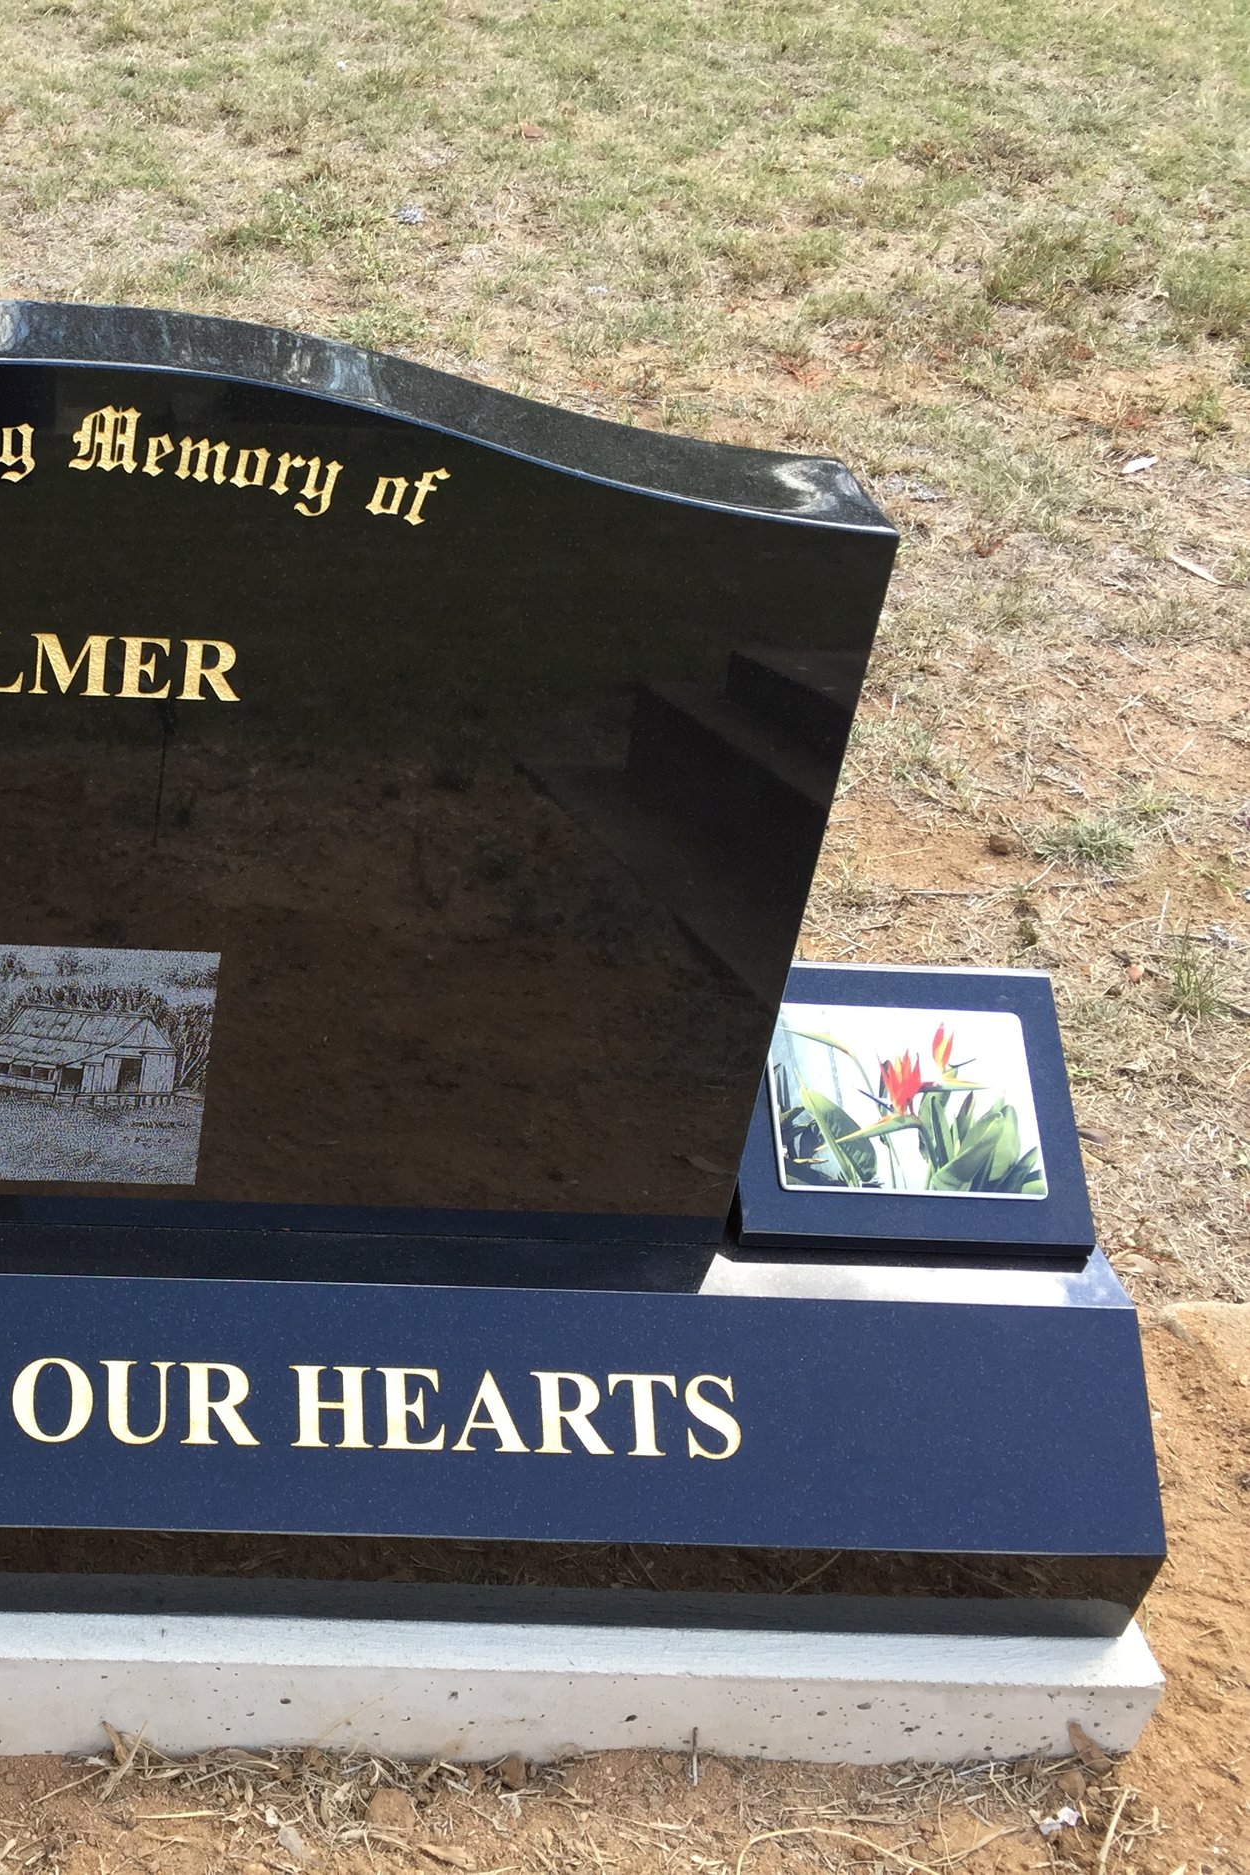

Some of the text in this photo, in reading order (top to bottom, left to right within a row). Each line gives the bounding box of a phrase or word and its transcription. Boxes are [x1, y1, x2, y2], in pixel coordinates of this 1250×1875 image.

[68, 404, 344, 517] Memory
[365, 467, 451, 526] of
[11, 1357, 261, 1446] OUR
[288, 1364, 742, 1460] HEARTS
